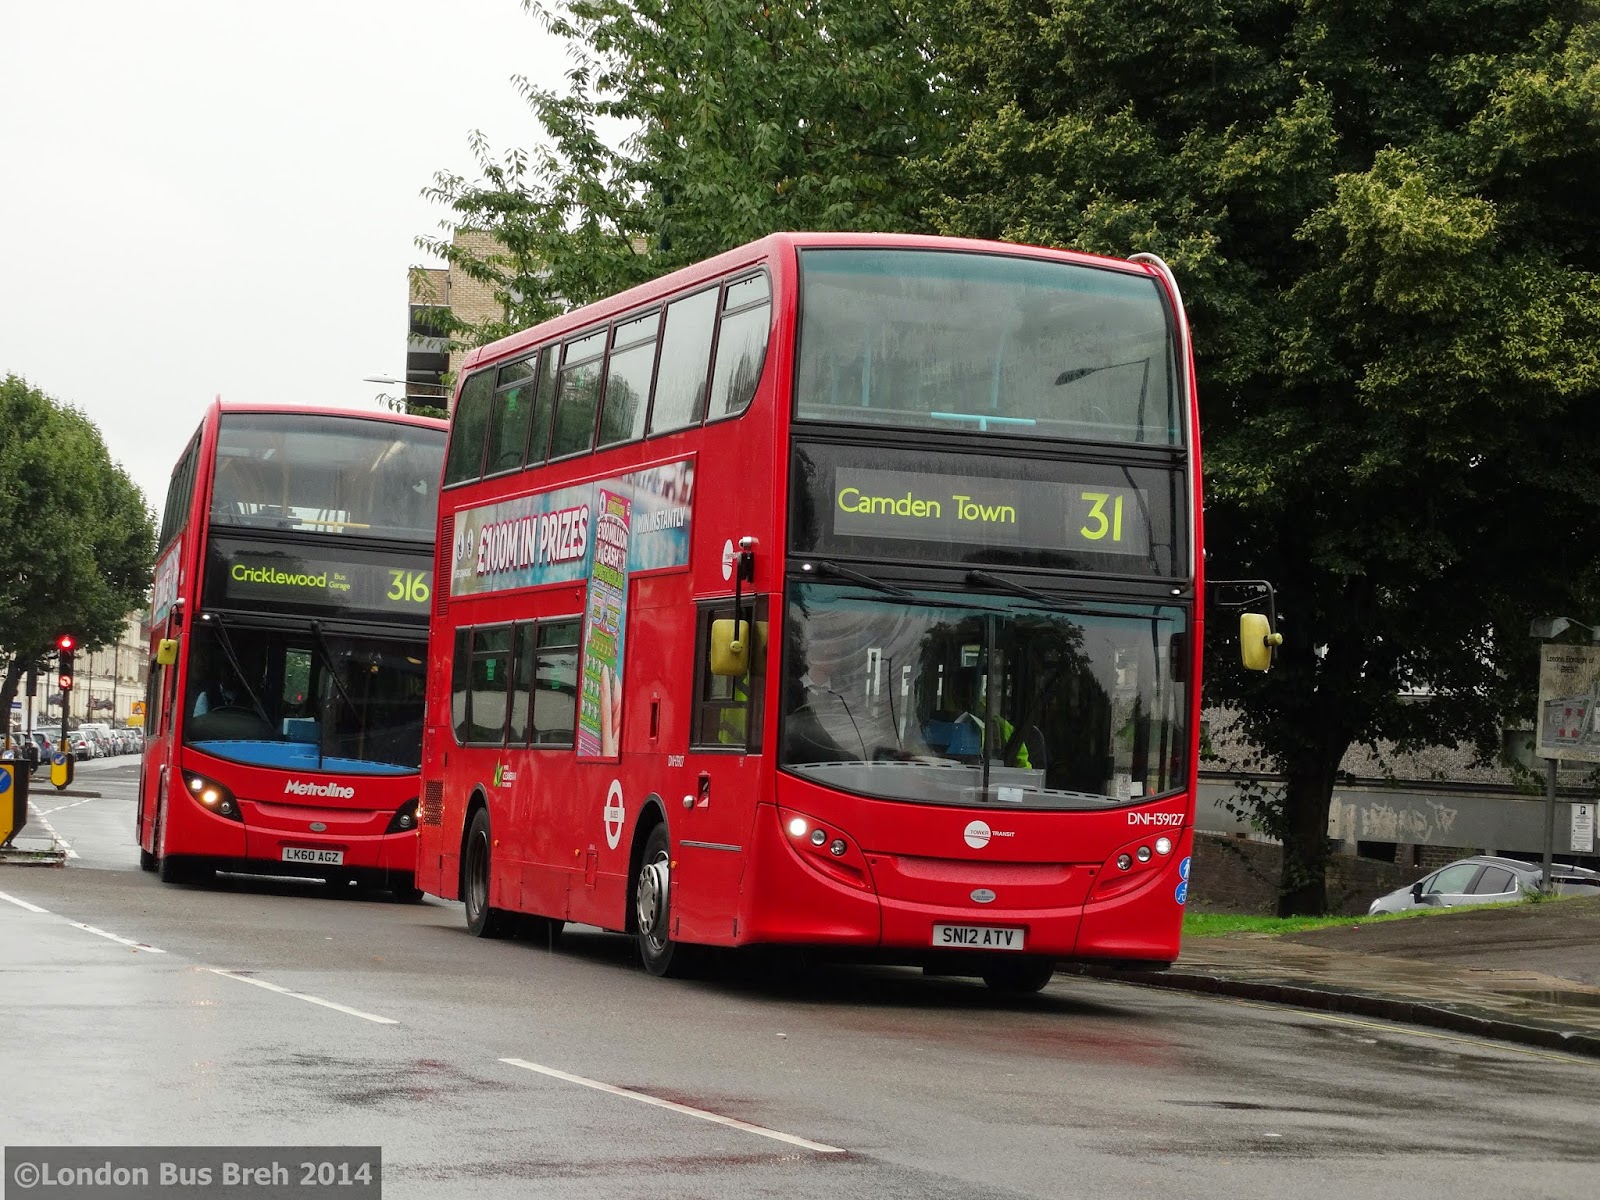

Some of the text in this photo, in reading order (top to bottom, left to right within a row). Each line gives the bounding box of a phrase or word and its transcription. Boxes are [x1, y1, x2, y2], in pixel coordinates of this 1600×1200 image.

[838, 488, 1016, 523] Camden Town
[649, 506, 686, 532] INSTANTLY
[1080, 491, 1124, 541] 31
[477, 520, 521, 575] £100M
[520, 515, 538, 569] IN
[539, 504, 589, 566] PRIZES
[231, 564, 327, 588] Cricklewood
[334, 572, 346, 581] Bus
[328, 581, 350, 591] Garage
[387, 569, 430, 603] 316
[1546, 655, 1565, 663] London
[1566, 655, 1586, 665] Borough
[284, 779, 355, 799] Metroline
[1127, 812, 1185, 826] DNH39127
[992, 830, 1015, 838] TRANSIT
[287, 849, 339, 863] LK60 AGZ
[943, 928, 1014, 946] SN12 ATV
